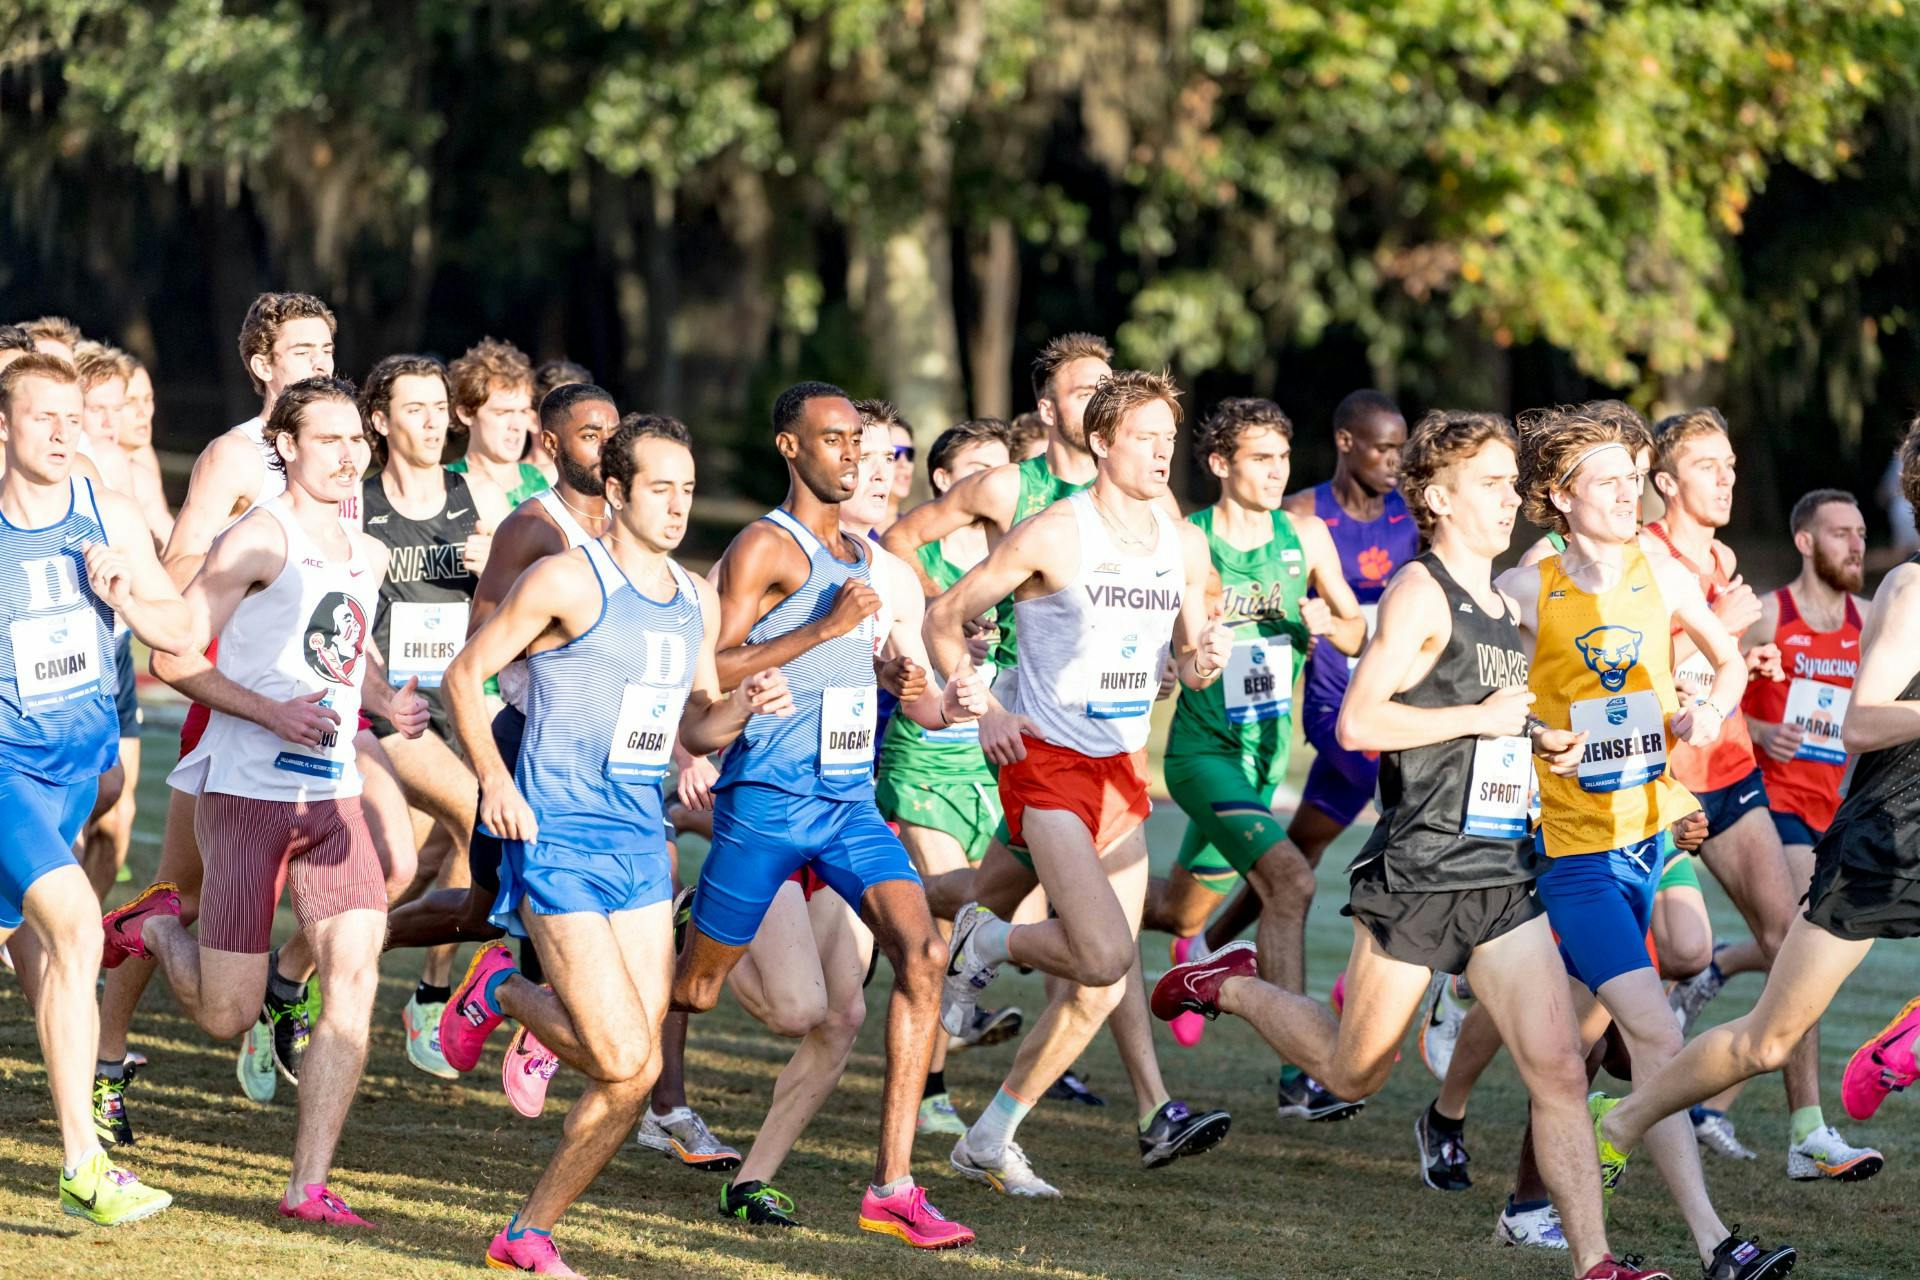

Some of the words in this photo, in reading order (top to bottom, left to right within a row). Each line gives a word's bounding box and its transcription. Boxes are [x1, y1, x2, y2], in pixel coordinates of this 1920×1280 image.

[302, 557, 323, 568] ACC
[388, 542, 470, 583] WAKE
[1085, 585, 1181, 610] VIRGINIA
[403, 642, 455, 659] EHLERS
[34, 652, 87, 681] CAVAN
[1476, 643, 1528, 688] WAKE
[1793, 652, 1858, 679] Syracuse
[1100, 672, 1147, 690] HUNTER
[1244, 674, 1275, 696] BERG
[829, 729, 871, 750] DAGANE
[1580, 732, 1662, 764] HENSELER
[1480, 781, 1521, 804] SPROTT
